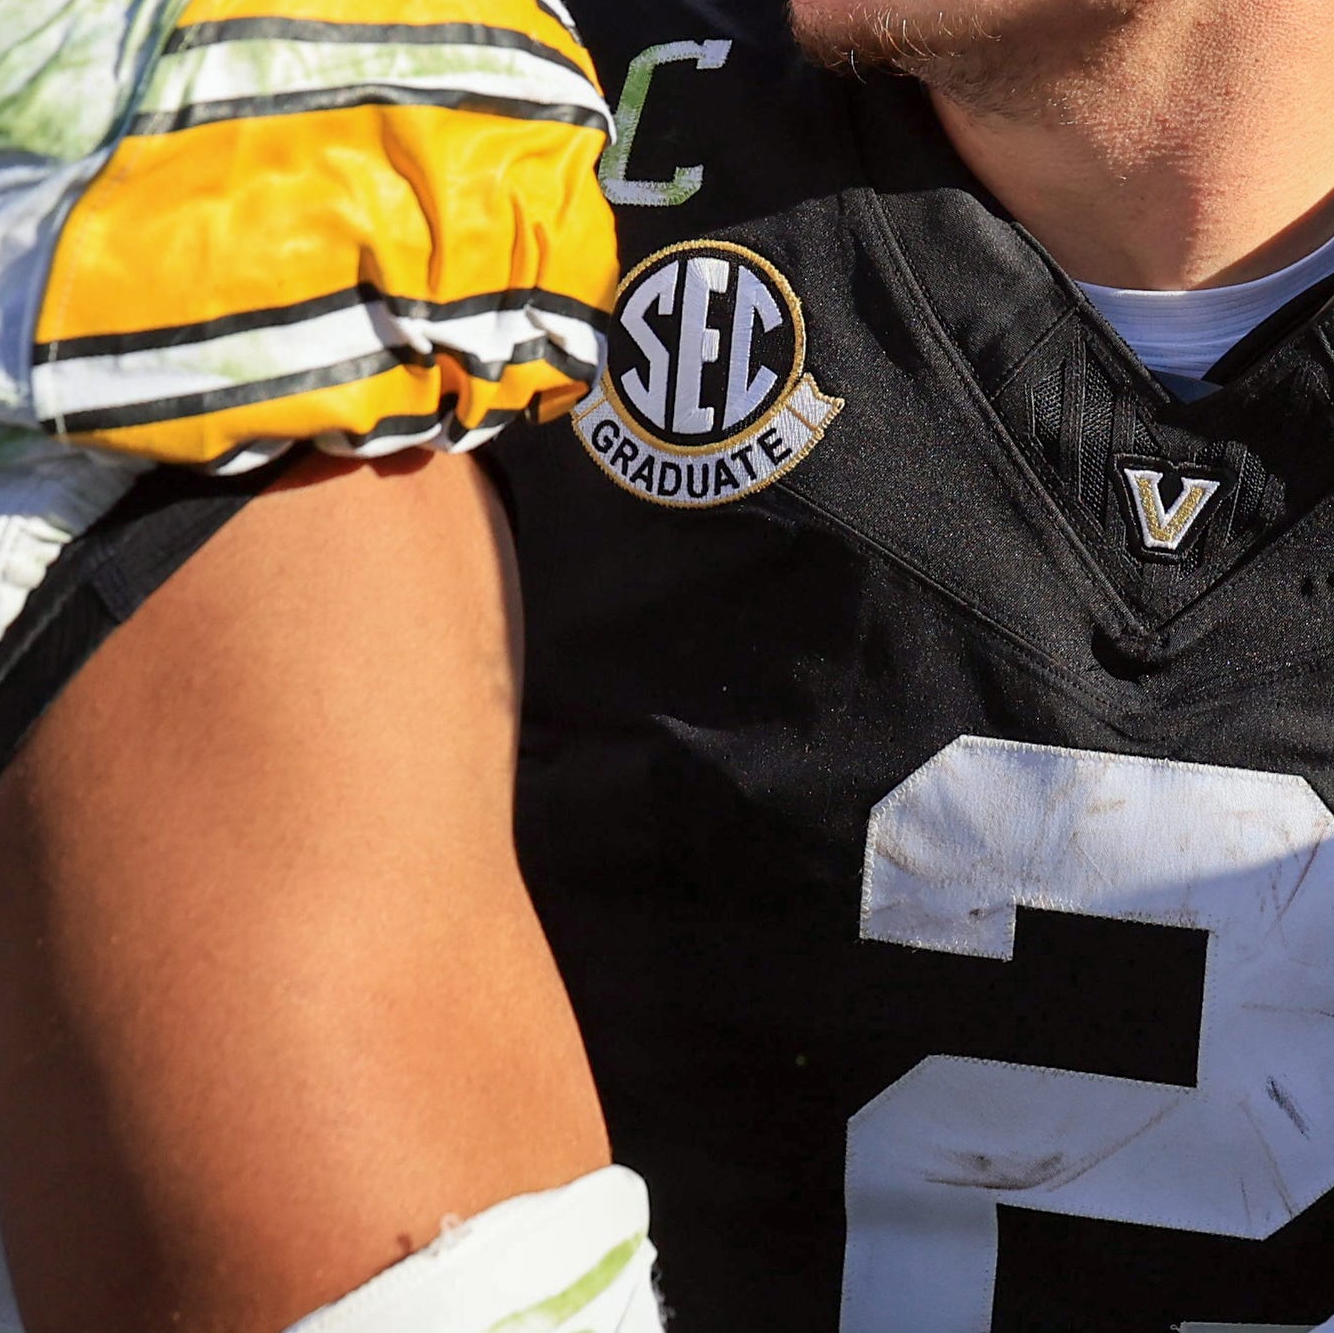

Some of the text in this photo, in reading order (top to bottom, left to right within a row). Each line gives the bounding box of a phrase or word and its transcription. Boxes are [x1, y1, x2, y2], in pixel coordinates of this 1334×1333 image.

[598, 38, 733, 207] C
[619, 256, 784, 436] SEC
[590, 418, 794, 499] GRADUATE
[1123, 467, 1221, 551] V
